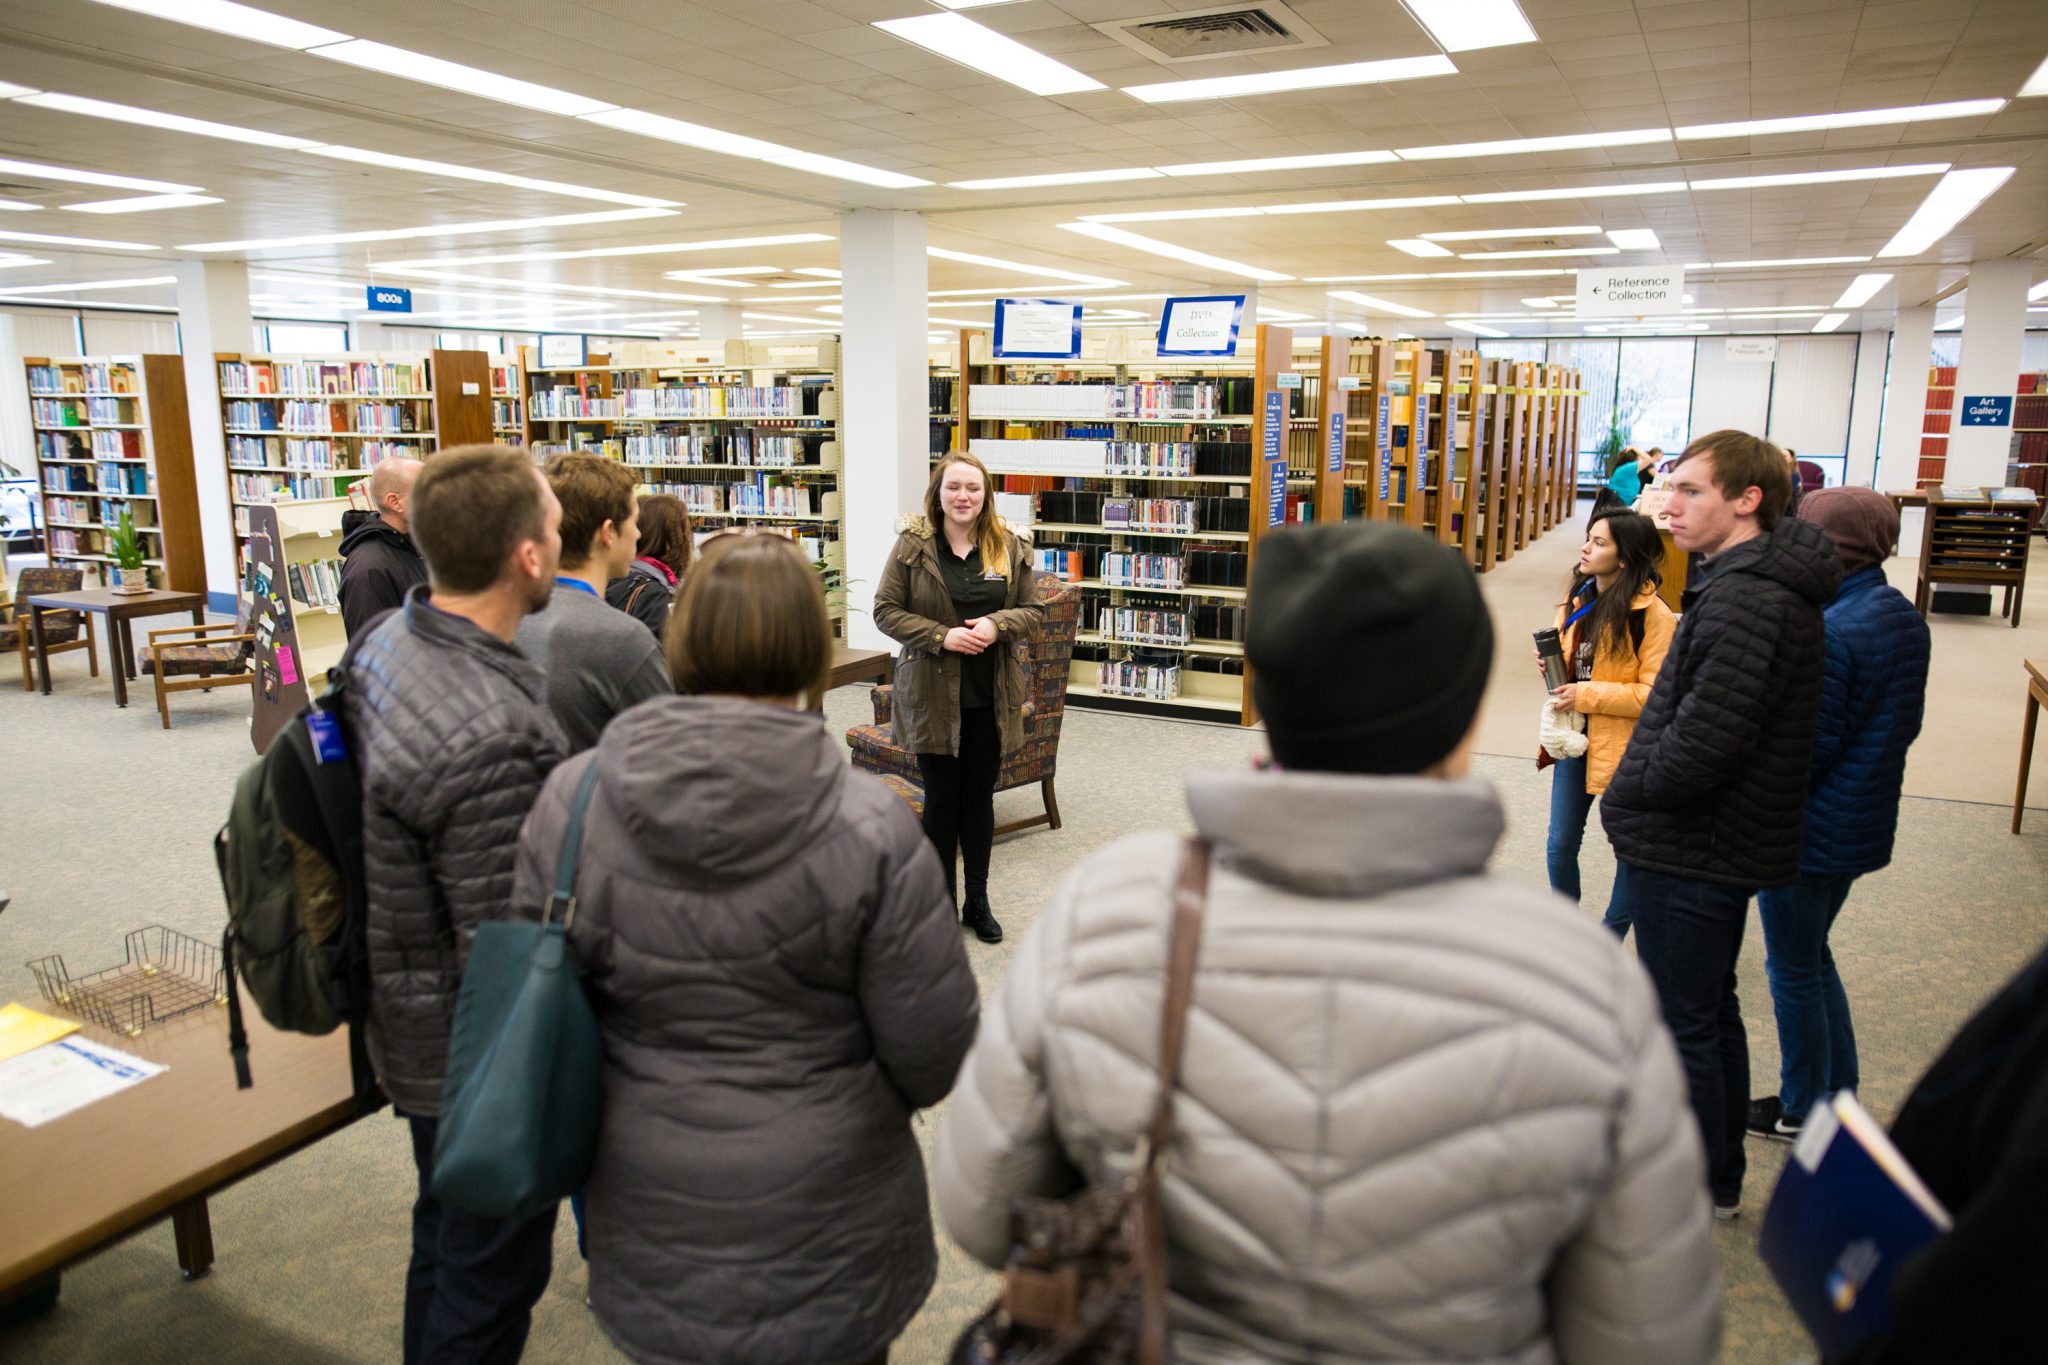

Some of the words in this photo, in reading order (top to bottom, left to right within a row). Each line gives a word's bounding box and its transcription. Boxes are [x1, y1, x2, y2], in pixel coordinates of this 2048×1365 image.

[1608, 278, 1670, 288] Reference
[1608, 290, 1666, 301] Collection
[1176, 327, 1219, 338] Collection
[1979, 398, 1995, 406] Art
[1969, 406, 2004, 416] Gallery
